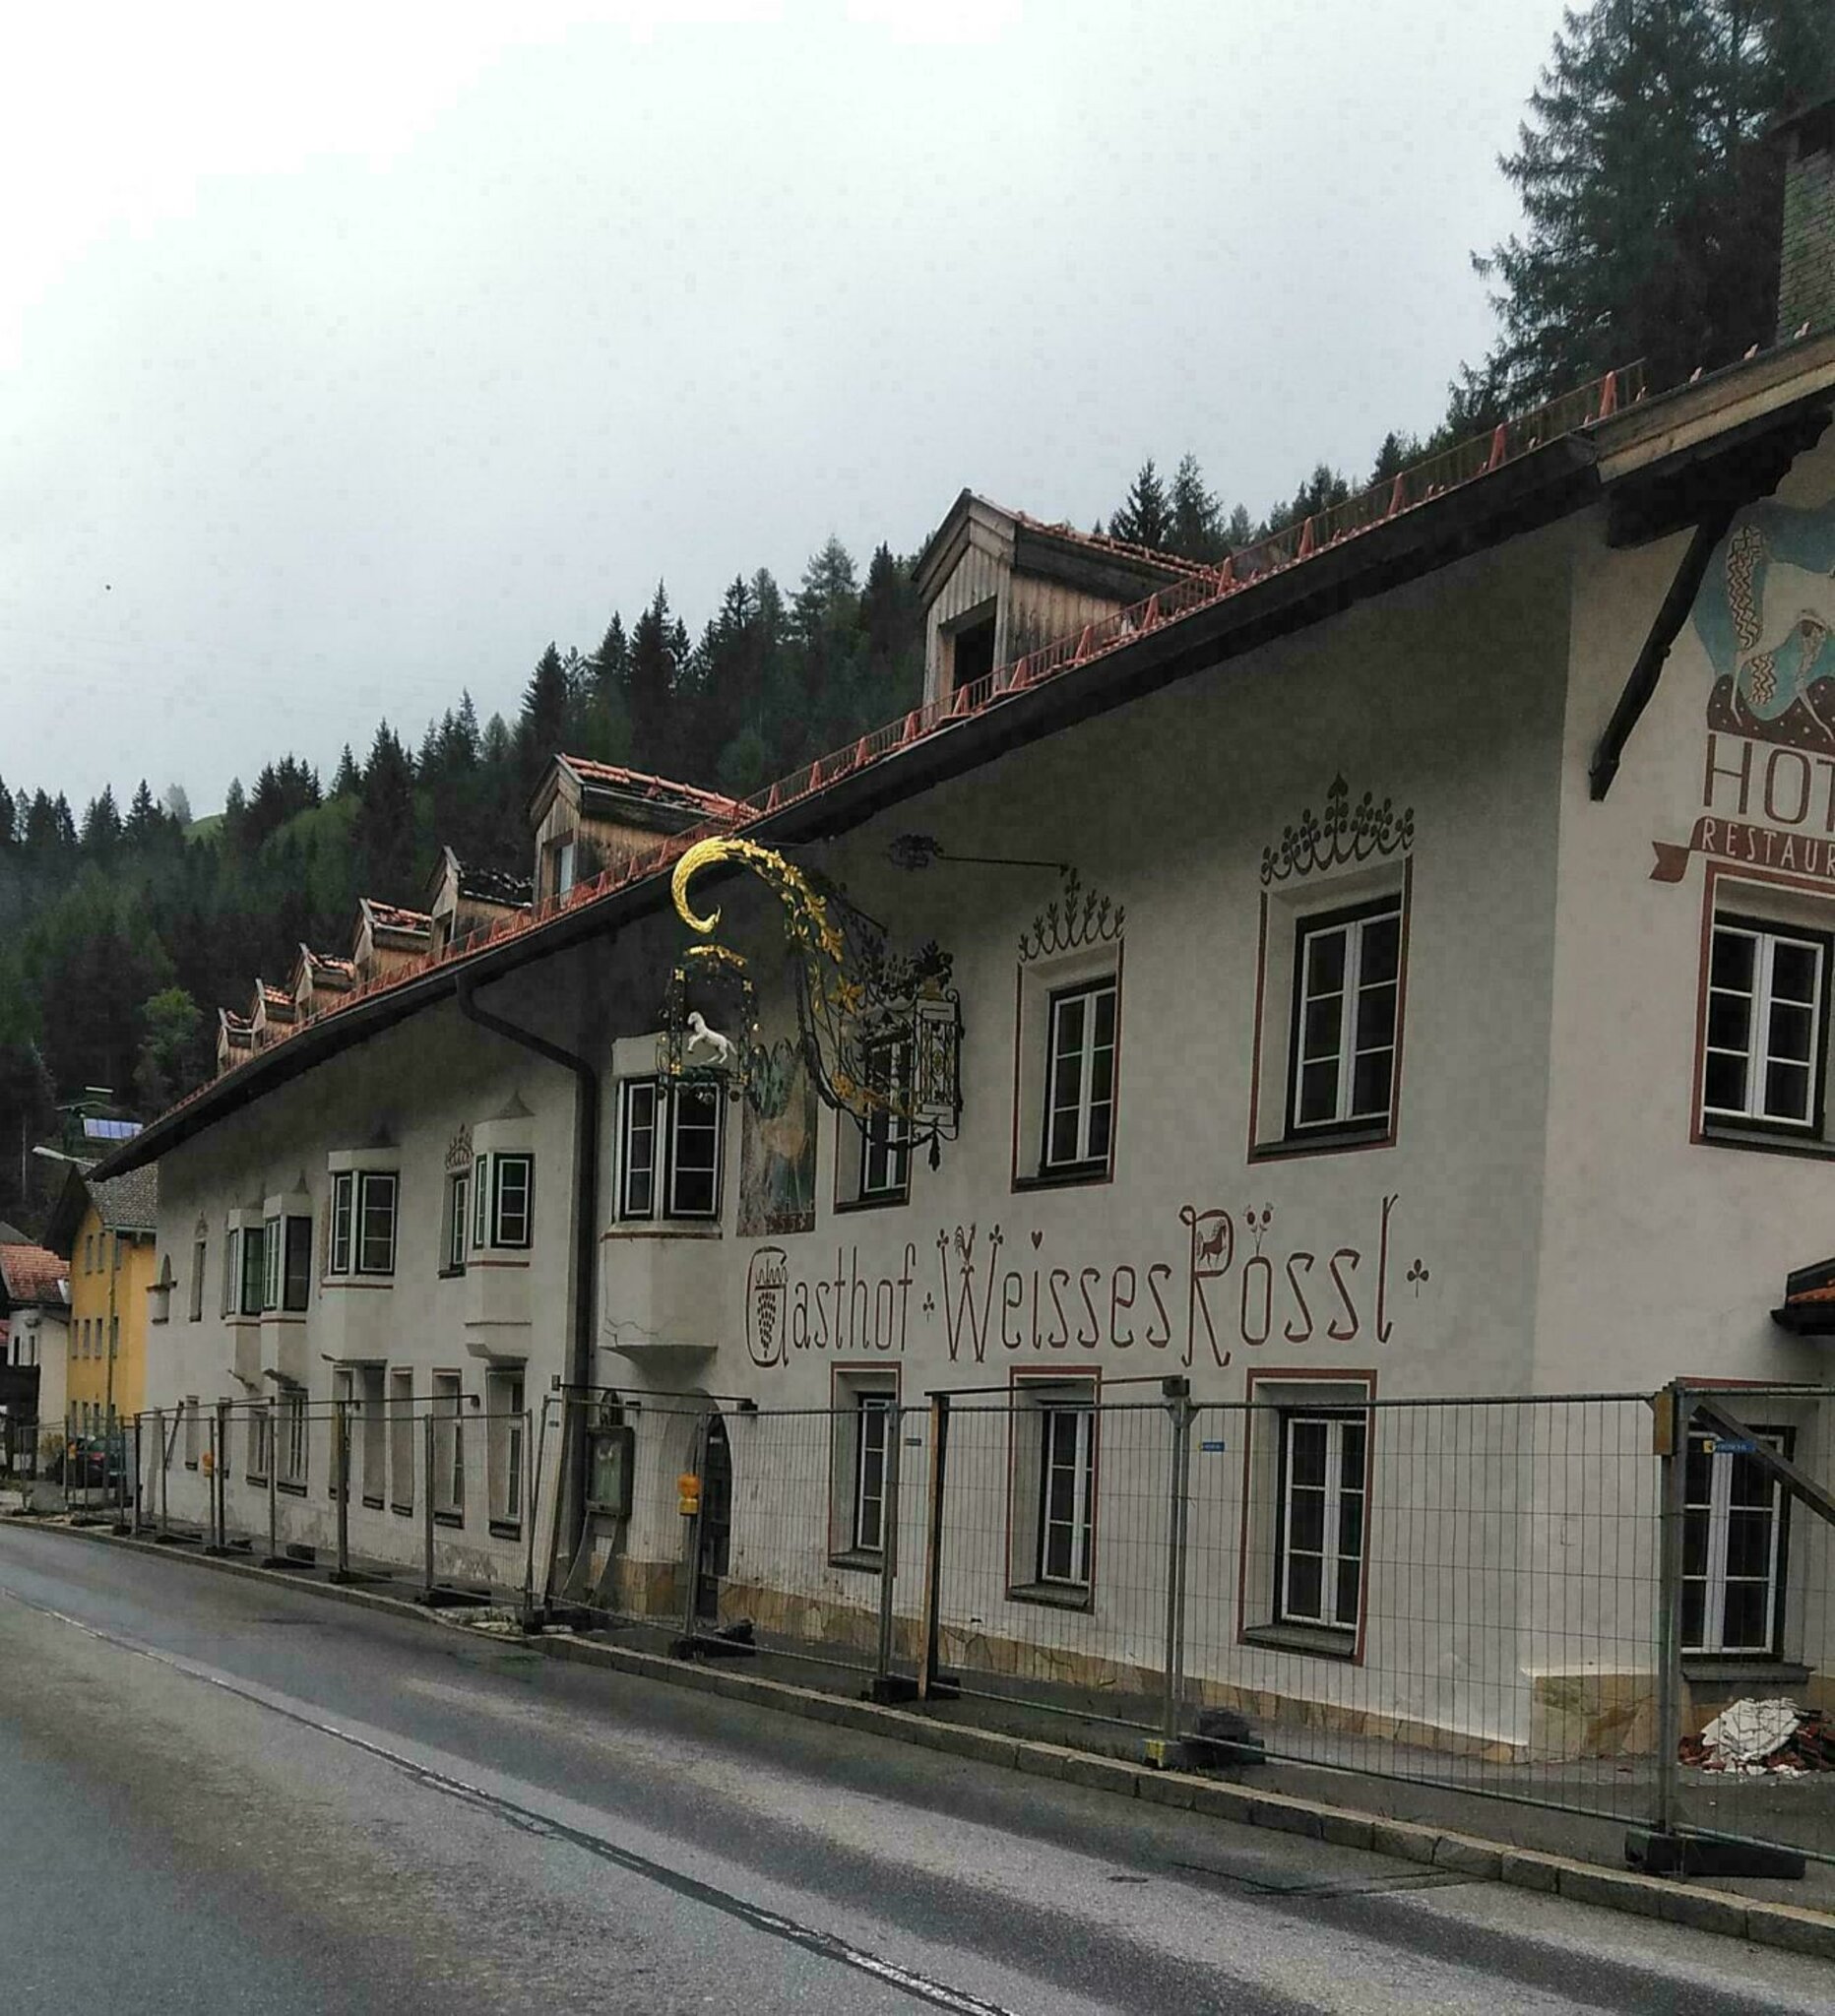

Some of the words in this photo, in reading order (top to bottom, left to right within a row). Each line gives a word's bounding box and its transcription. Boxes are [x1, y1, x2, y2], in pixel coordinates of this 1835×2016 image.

[746, 1242, 916, 1367] Gasthof
[937, 1227, 1171, 1362] Weisses
[1178, 1193, 1399, 1367] Rössl
